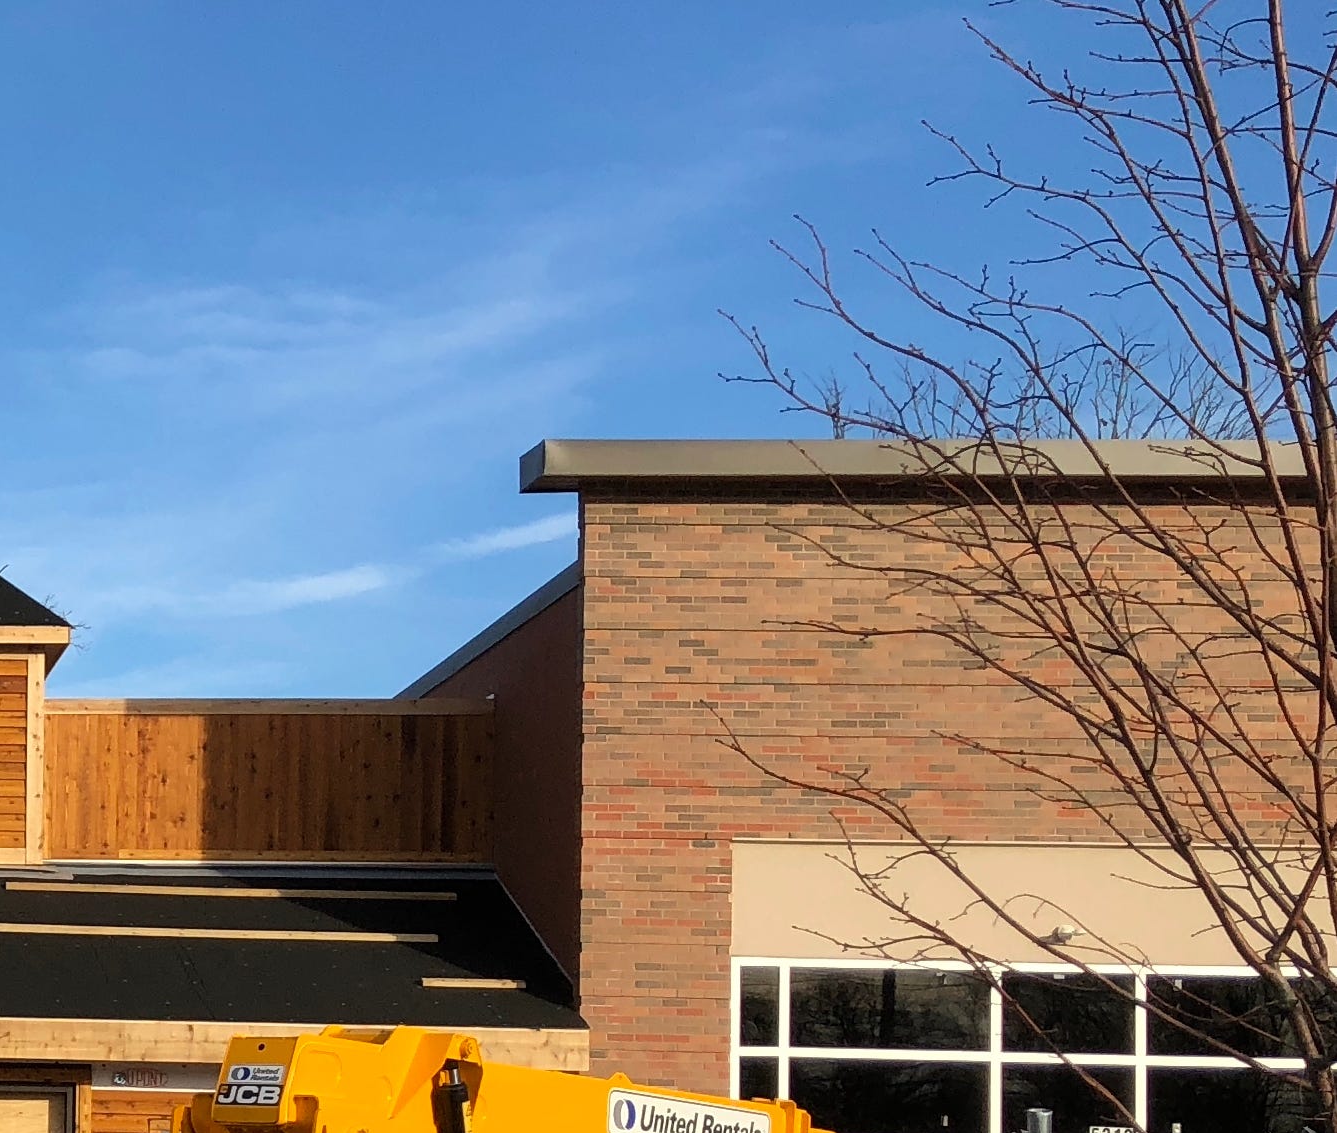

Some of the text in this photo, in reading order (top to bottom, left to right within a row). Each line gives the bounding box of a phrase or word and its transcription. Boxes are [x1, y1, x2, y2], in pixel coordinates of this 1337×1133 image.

[127, 1070, 166, 1087] UPONT
[252, 1067, 280, 1075] United
[217, 1085, 281, 1104] JCB
